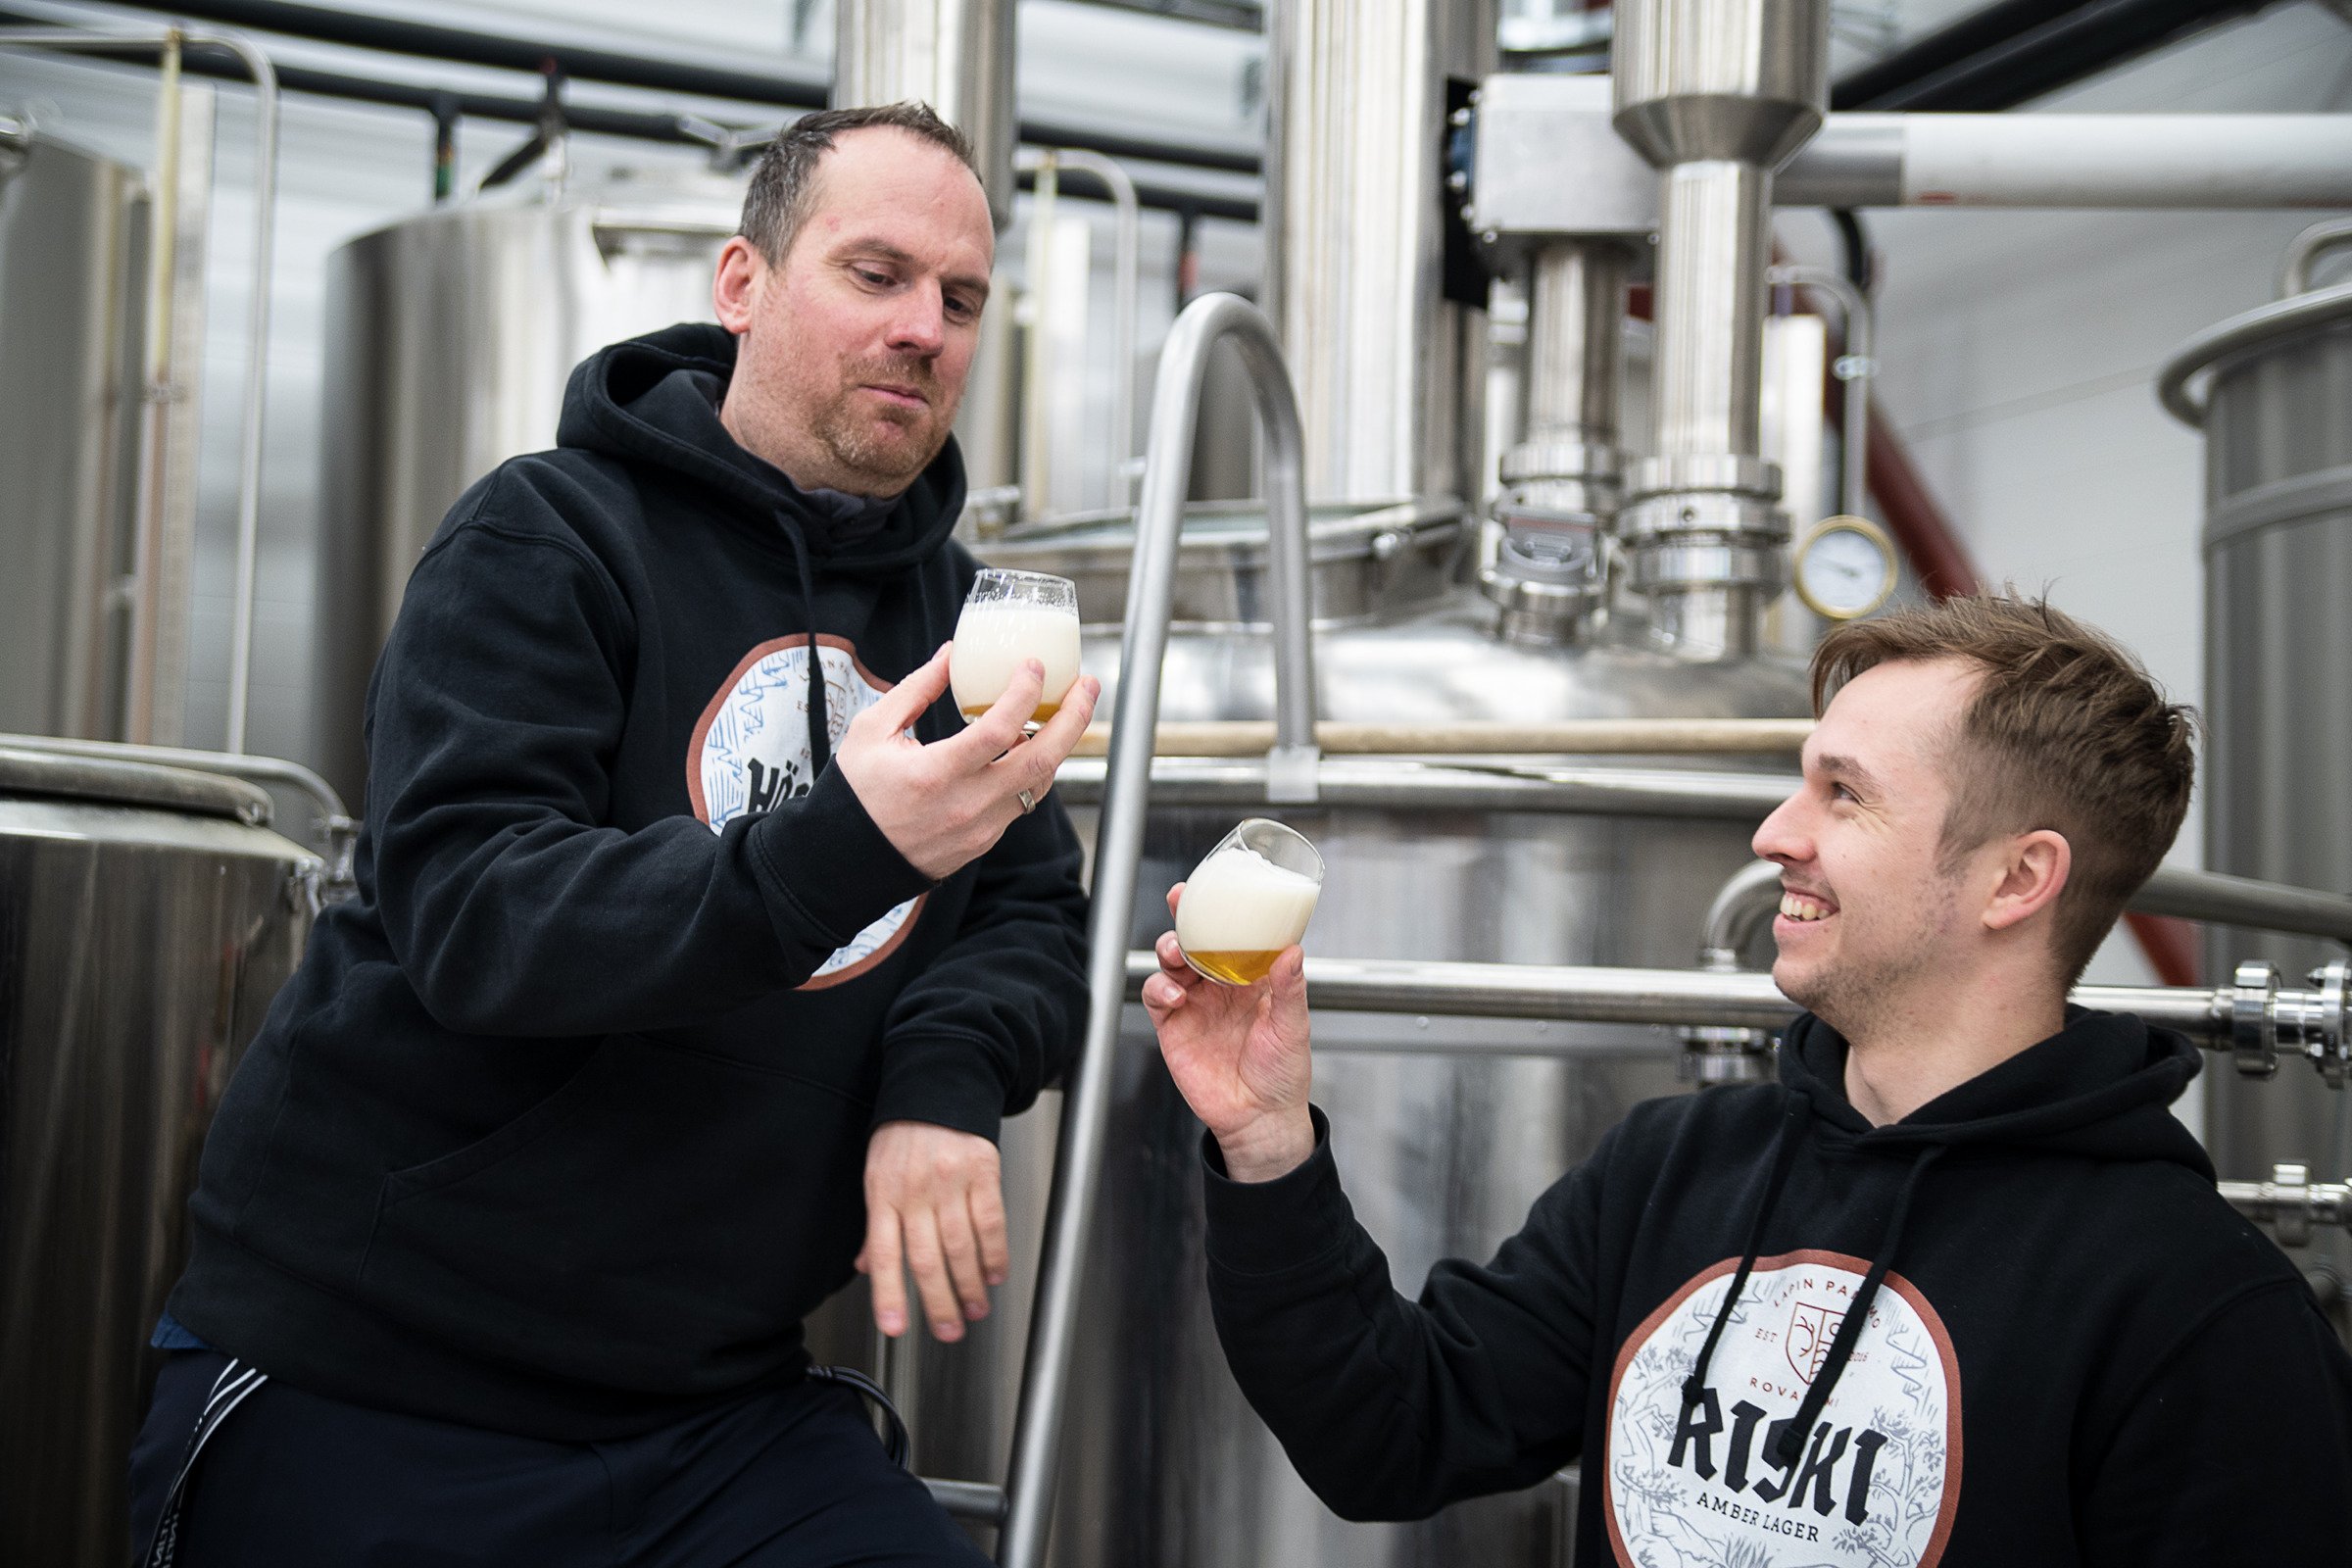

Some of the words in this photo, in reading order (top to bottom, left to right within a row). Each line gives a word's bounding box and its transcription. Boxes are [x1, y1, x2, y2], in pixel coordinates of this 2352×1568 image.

[1826, 1281, 1881, 1328] PAMO
[1755, 1328, 1778, 1343] EST
[1750, 1377, 1839, 1407] ROVAMI
[1667, 1387, 1887, 1526] RISKI
[1697, 1493, 1761, 1525] AMBER
[1762, 1514, 1818, 1542] LAGER
